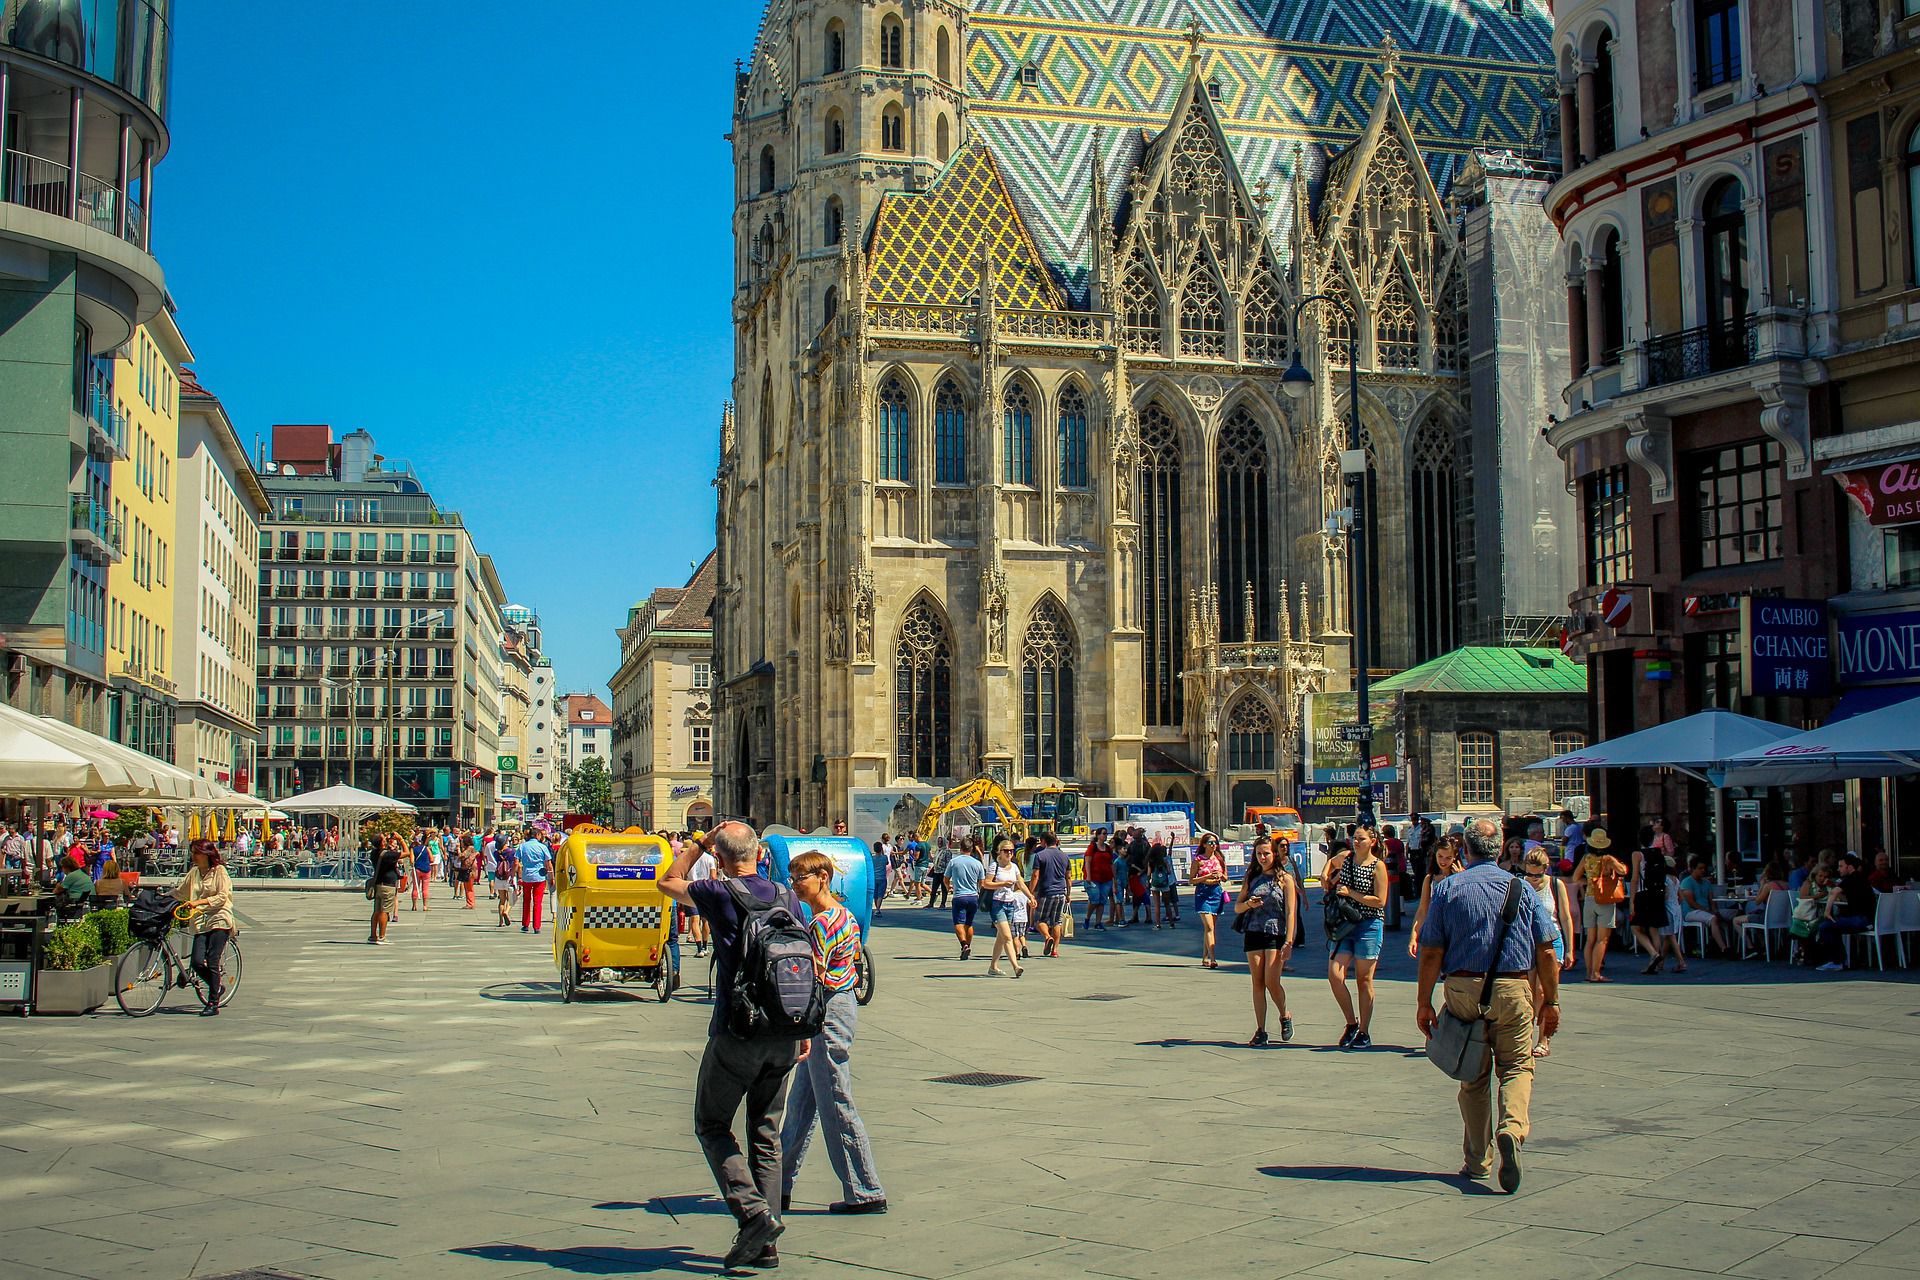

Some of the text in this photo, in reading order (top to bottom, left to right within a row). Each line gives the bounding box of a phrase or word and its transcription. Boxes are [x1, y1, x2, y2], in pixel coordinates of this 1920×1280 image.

[1887, 502, 1913, 517] DAS
[1761, 607, 1818, 626] CAMBIO
[1753, 635, 1828, 658] CHANGE
[1316, 727, 1341, 740] MONE
[1316, 741, 1353, 753] PICASSO
